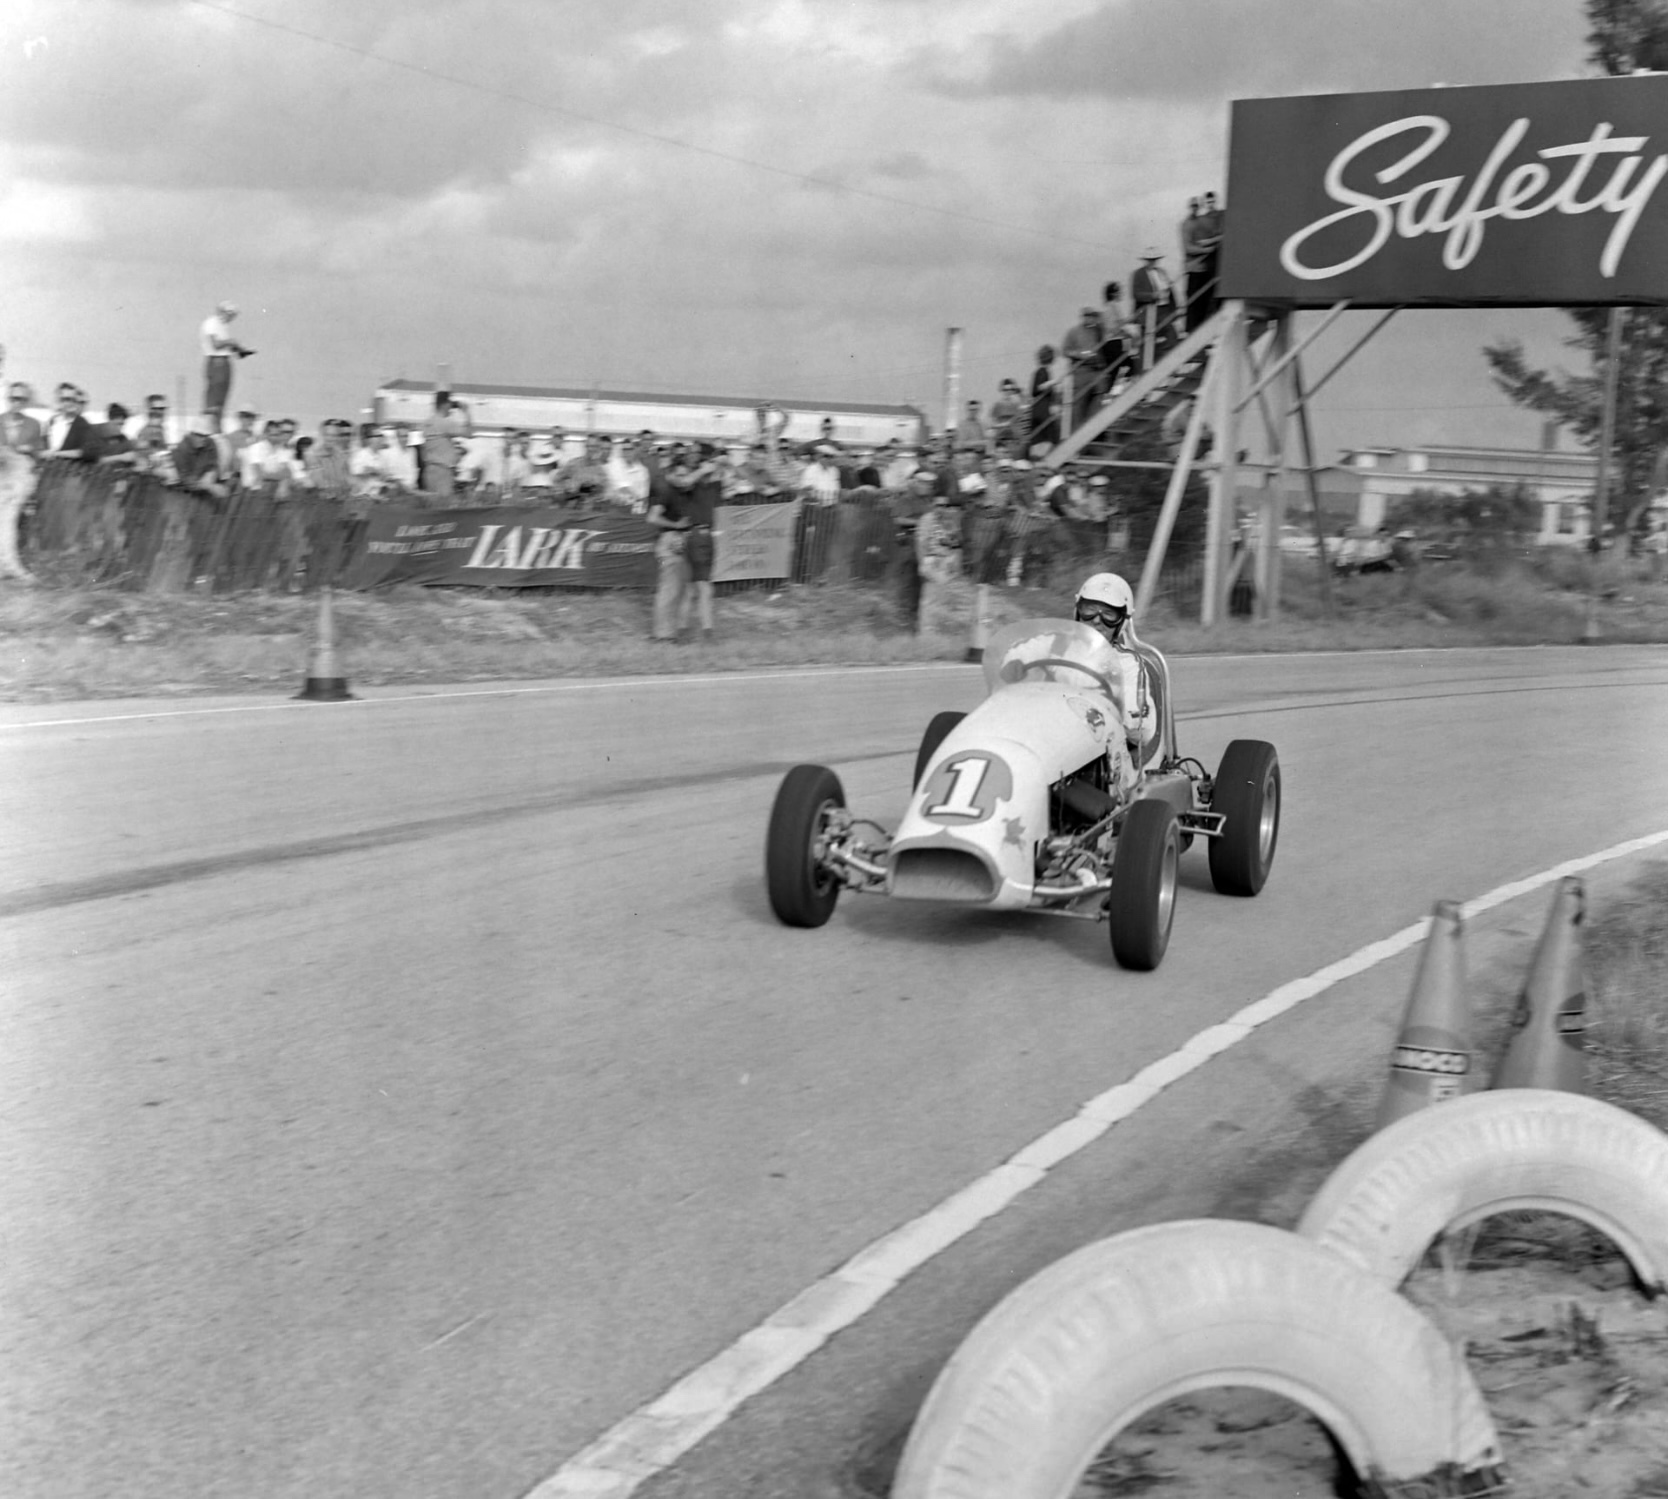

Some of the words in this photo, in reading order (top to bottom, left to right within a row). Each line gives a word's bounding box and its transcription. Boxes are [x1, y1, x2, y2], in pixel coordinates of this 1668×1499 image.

[1280, 115, 1668, 280] Safety
[461, 524, 607, 570] LARK
[924, 756, 991, 819] 1
